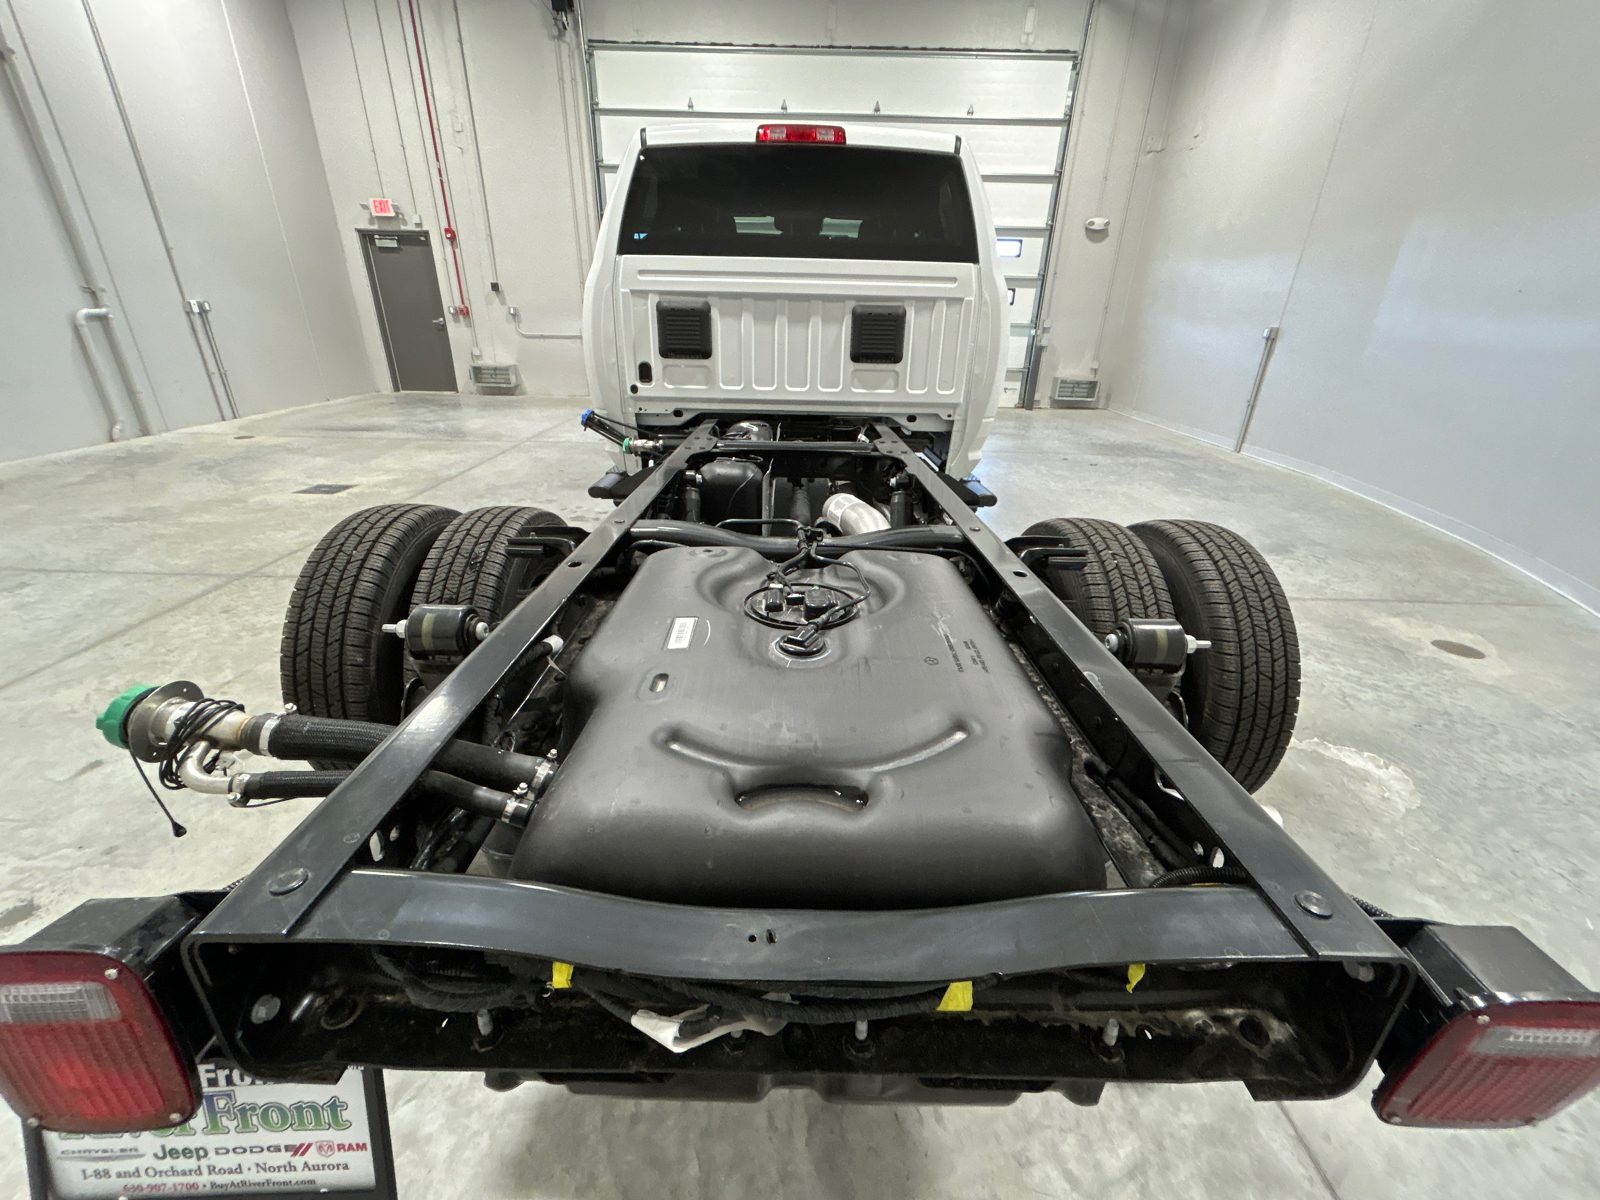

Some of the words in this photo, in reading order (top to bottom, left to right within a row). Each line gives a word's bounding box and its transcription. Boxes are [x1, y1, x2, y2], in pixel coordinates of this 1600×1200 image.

[372, 199, 391, 214] EXIT
[153, 1144, 209, 1161] Jeep
[214, 1144, 298, 1156] DODGE
[336, 1142, 368, 1153] RAM
[115, 1167, 141, 1179] and
[144, 1165, 203, 1178] Orchard
[207, 1163, 243, 1176] Road
[255, 1161, 297, 1174] North
[301, 1161, 350, 1173] Aurora
[210, 1179, 317, 1190] BuyAtRiverFront.com
